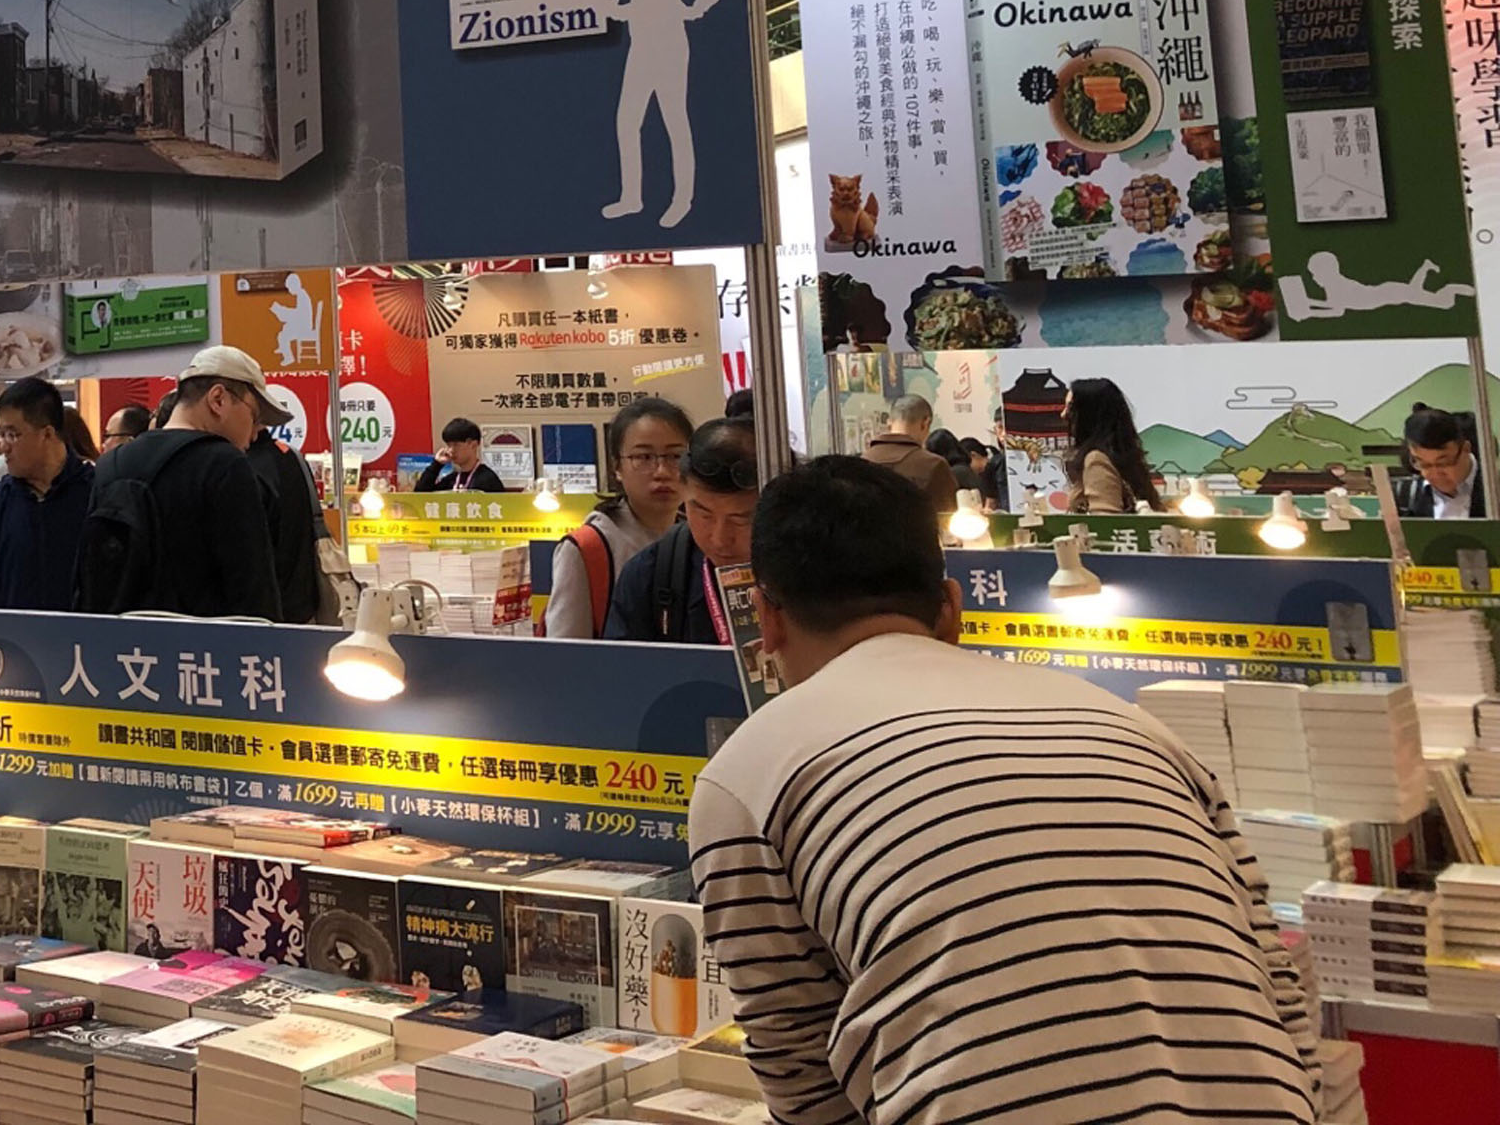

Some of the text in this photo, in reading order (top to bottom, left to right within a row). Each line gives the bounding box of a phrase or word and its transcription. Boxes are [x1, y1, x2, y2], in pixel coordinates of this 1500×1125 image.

[458, 3, 600, 45] Zionism
[994, 0, 1133, 28] Okinawa
[852, 238, 957, 259] Okinawa
[445, 333, 518, 350] 可獨家獲得
[519, 331, 572, 347] Rakuten
[573, 329, 606, 344] kobo
[607, 328, 635, 346] 5折
[340, 417, 393, 443] 240 元
[424, 502, 503, 519] 健康飲食
[971, 568, 1008, 608] 科
[1254, 630, 1293, 652] 240
[59, 643, 287, 714] 人文社科
[98, 722, 176, 750] 讀書共和國
[605, 759, 657, 791] 240
[132, 861, 156, 921] 天使
[182, 853, 210, 917] 垃圾
[405, 913, 495, 944] 精神病大流行
[622, 907, 651, 1029] 沒好藥？
